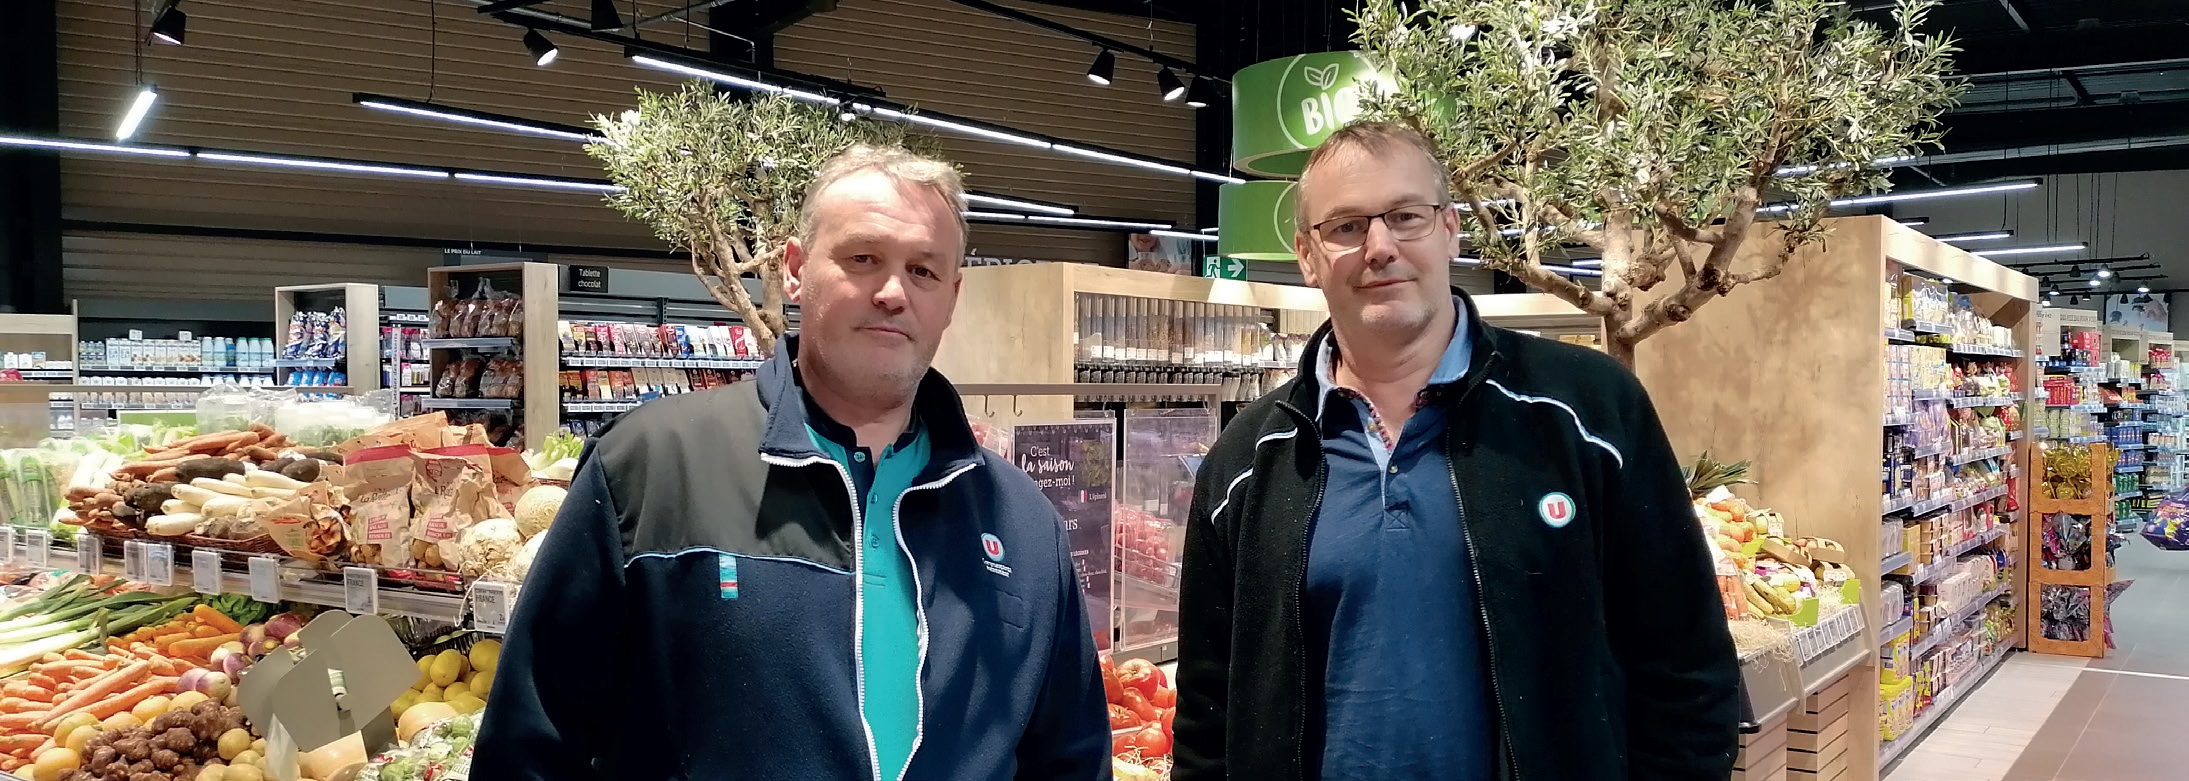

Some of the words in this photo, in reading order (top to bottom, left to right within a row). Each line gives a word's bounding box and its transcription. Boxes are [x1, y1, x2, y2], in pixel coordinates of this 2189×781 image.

[579, 268, 600, 278] Tablette
[577, 280, 601, 288] chocolat
[1030, 446, 1050, 457] C'est
[1021, 453, 1036, 473] la
[1037, 457, 1075, 474] saison
[1547, 501, 1567, 520] U
[986, 539, 1000, 556] U
[475, 594, 496, 604] FRANCE
